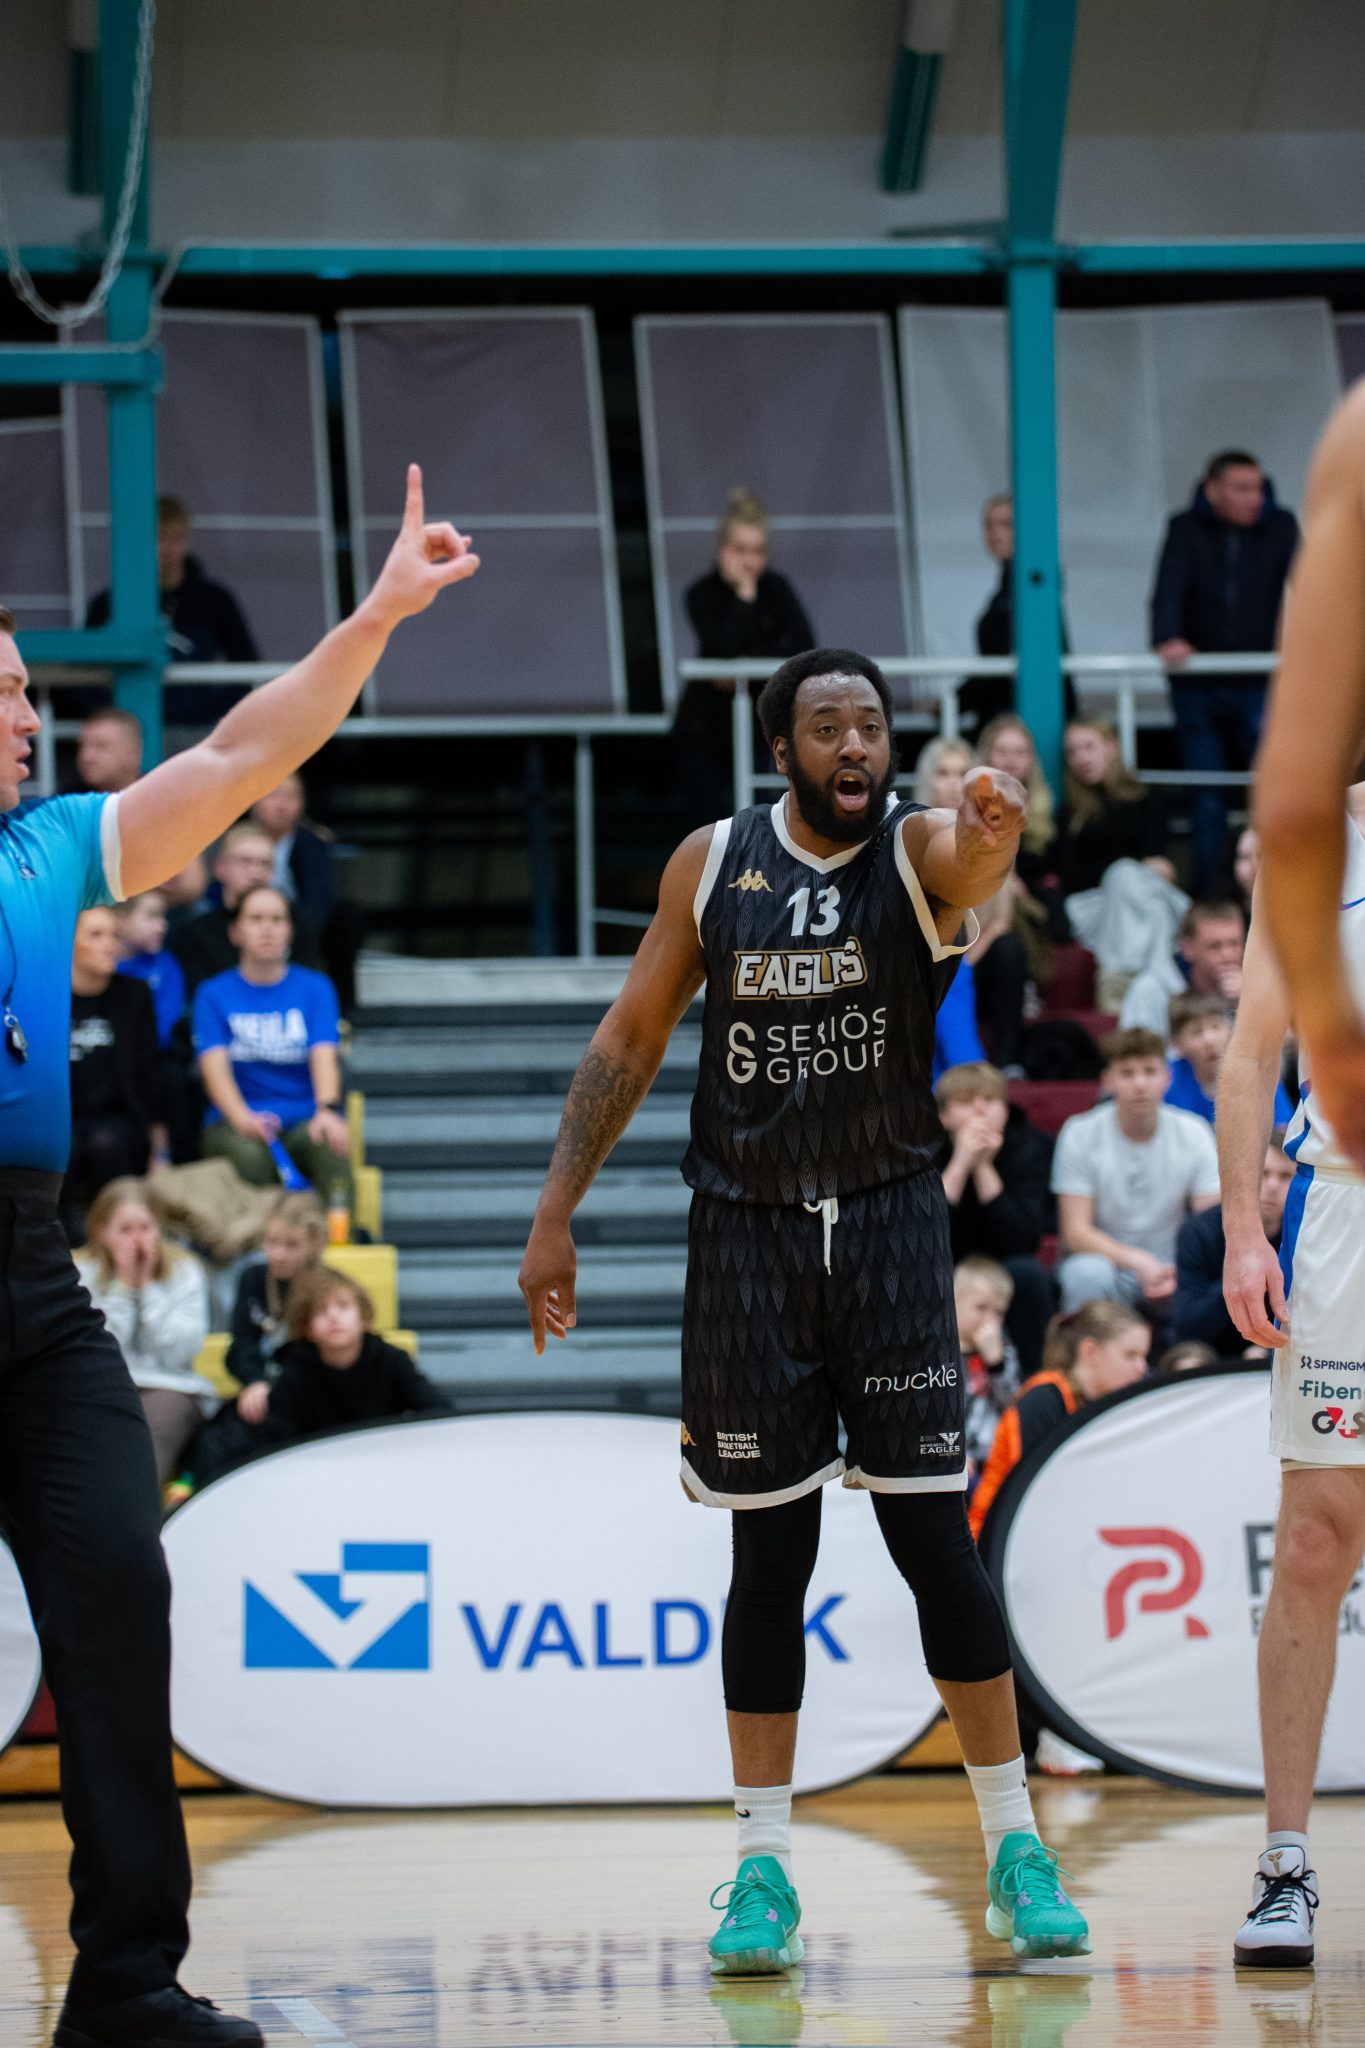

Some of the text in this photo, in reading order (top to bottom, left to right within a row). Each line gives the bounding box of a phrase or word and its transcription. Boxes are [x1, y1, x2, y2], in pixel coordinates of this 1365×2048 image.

[787, 885, 842, 936] 13
[735, 938, 866, 998] EAGLES
[766, 1004, 887, 1053] SERIÖS
[766, 1039, 885, 1084] GROUP
[864, 1364, 958, 1394] muckle
[1313, 1359, 1365, 1371] SPRINGM
[1298, 1379, 1365, 1400] Fiben
[716, 1431, 758, 1442] BRITISH
[919, 1445, 961, 1455] EAGLES
[718, 1449, 762, 1459] LEAGUE
[459, 1594, 851, 1670] VALDK
